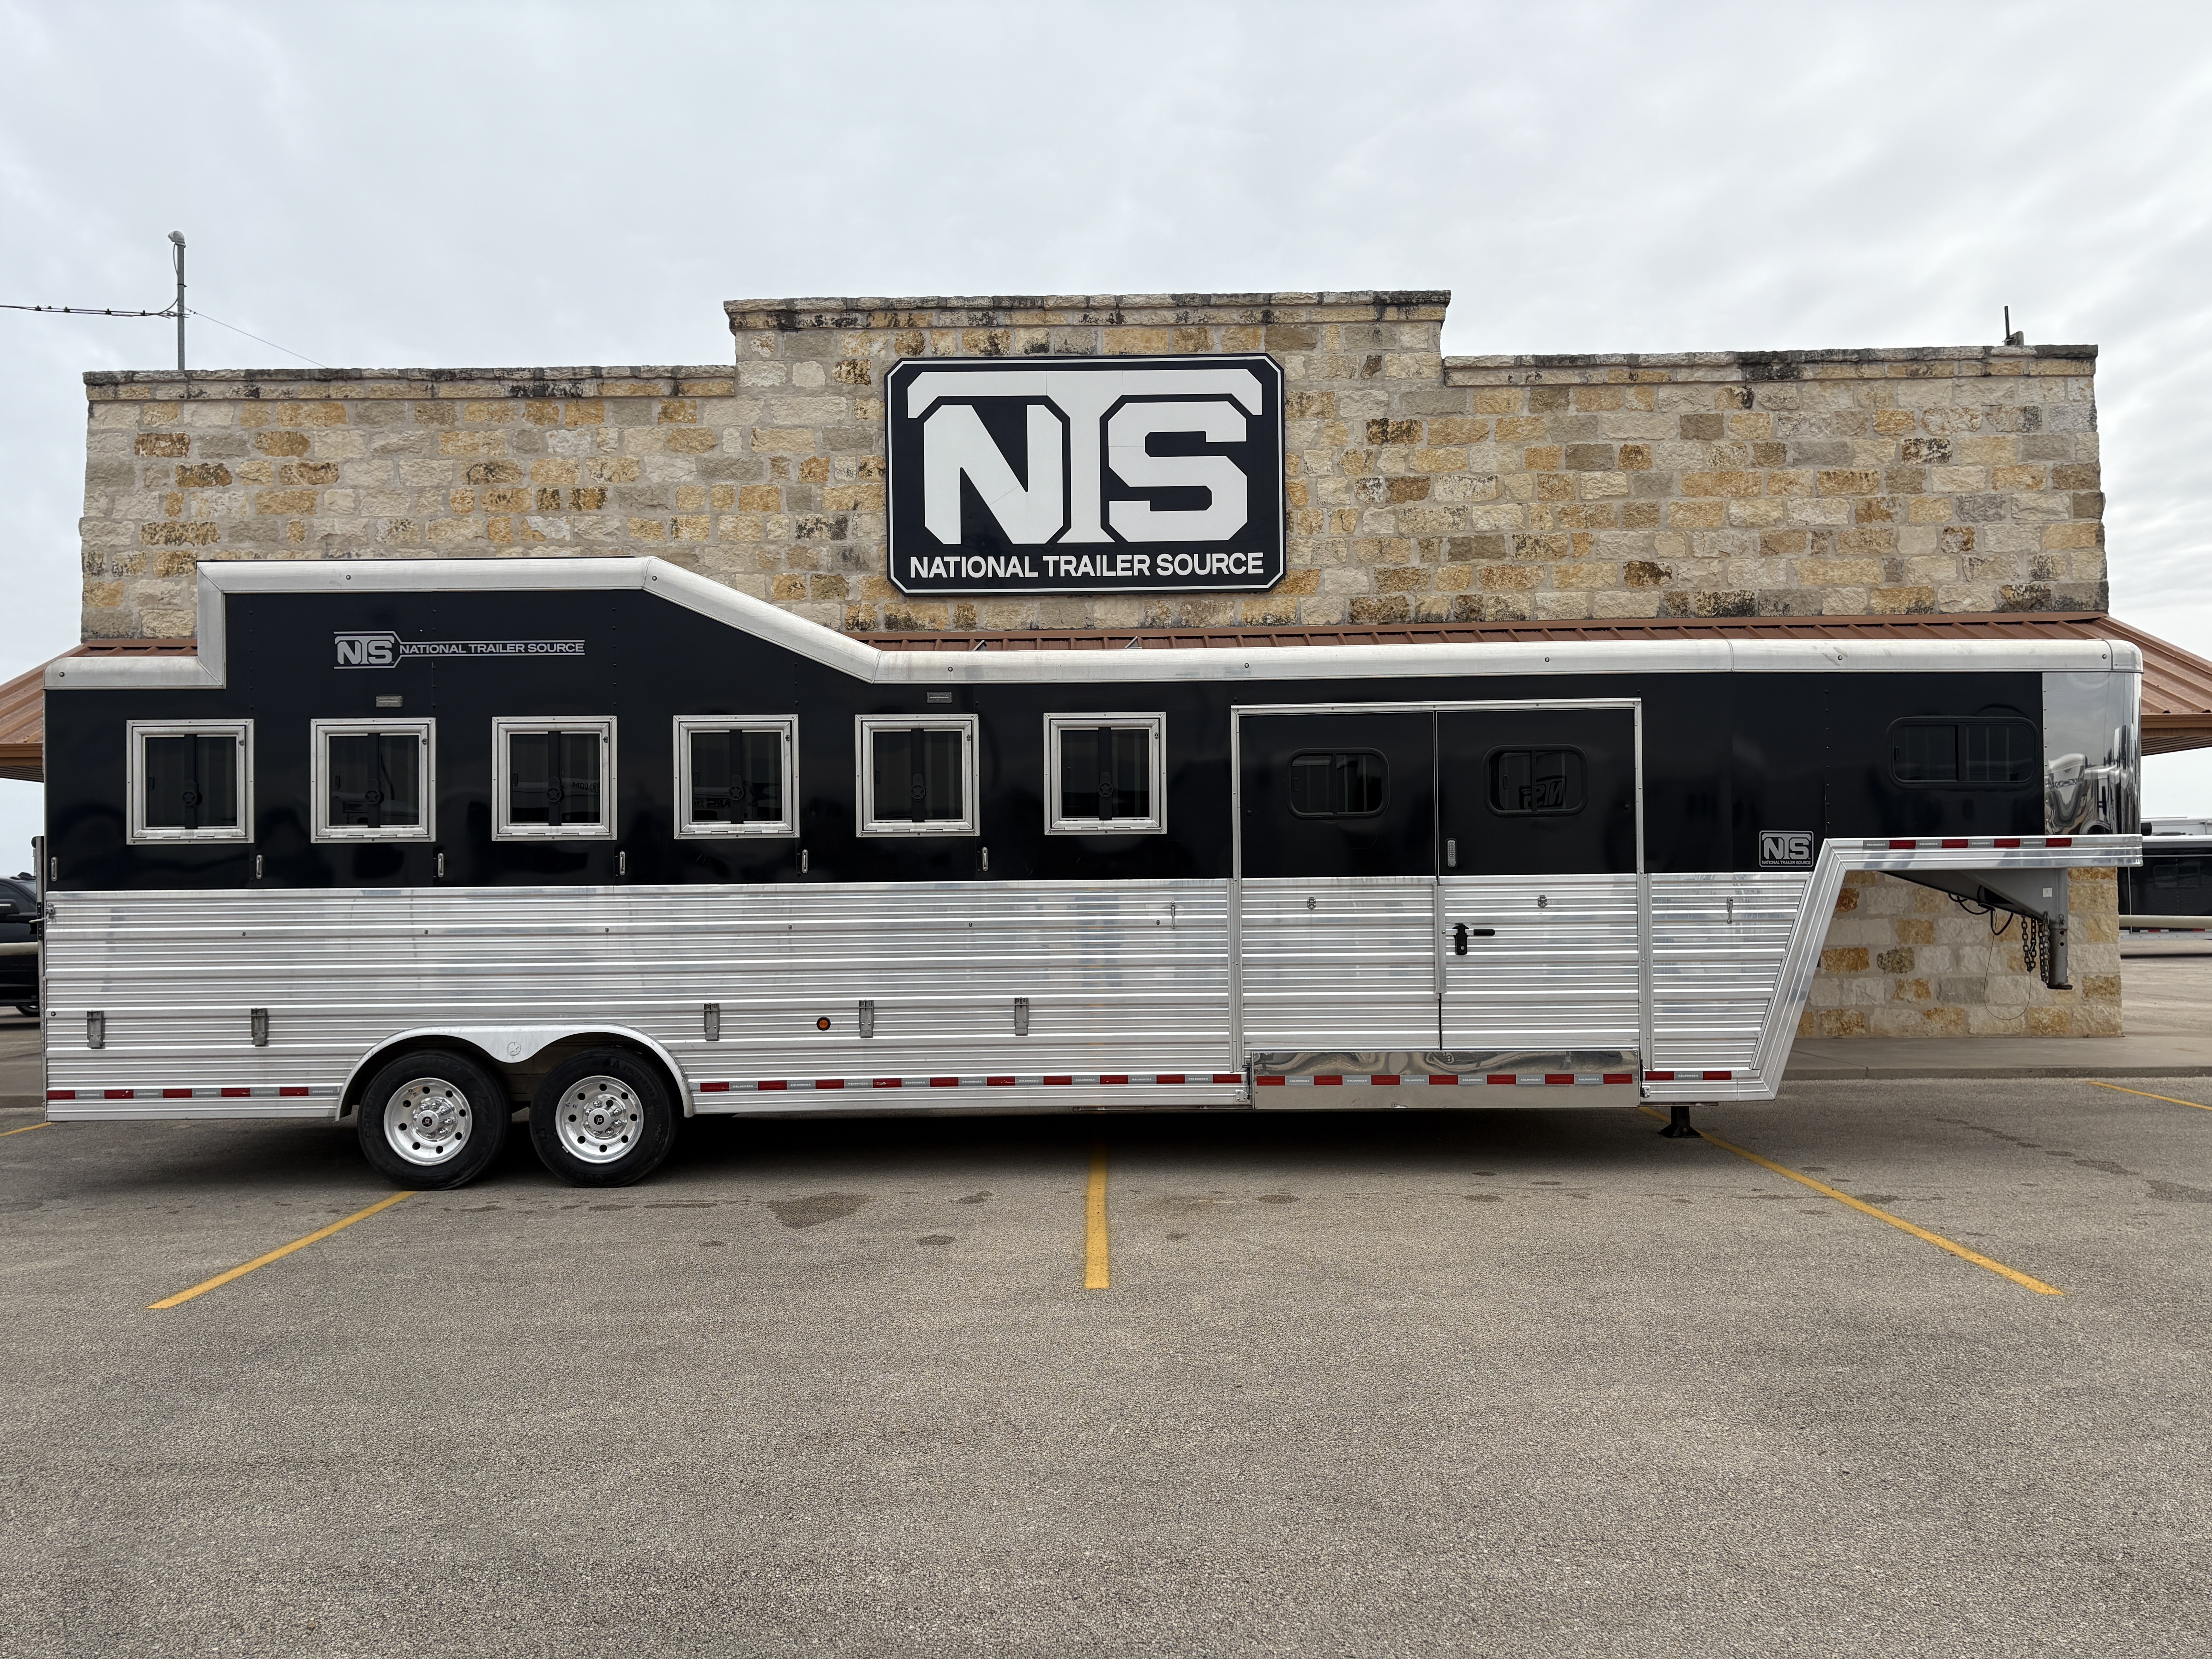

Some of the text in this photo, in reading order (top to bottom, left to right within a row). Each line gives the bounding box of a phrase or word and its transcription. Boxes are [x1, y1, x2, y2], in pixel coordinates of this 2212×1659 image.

[907, 369, 1262, 544] NTS
[910, 552, 1264, 578] NATIONAL TRAILER SOURCE
[335, 635, 584, 665] NTS NATIONAL TRAILER SOURCE
[1762, 833, 1811, 860] NTS
